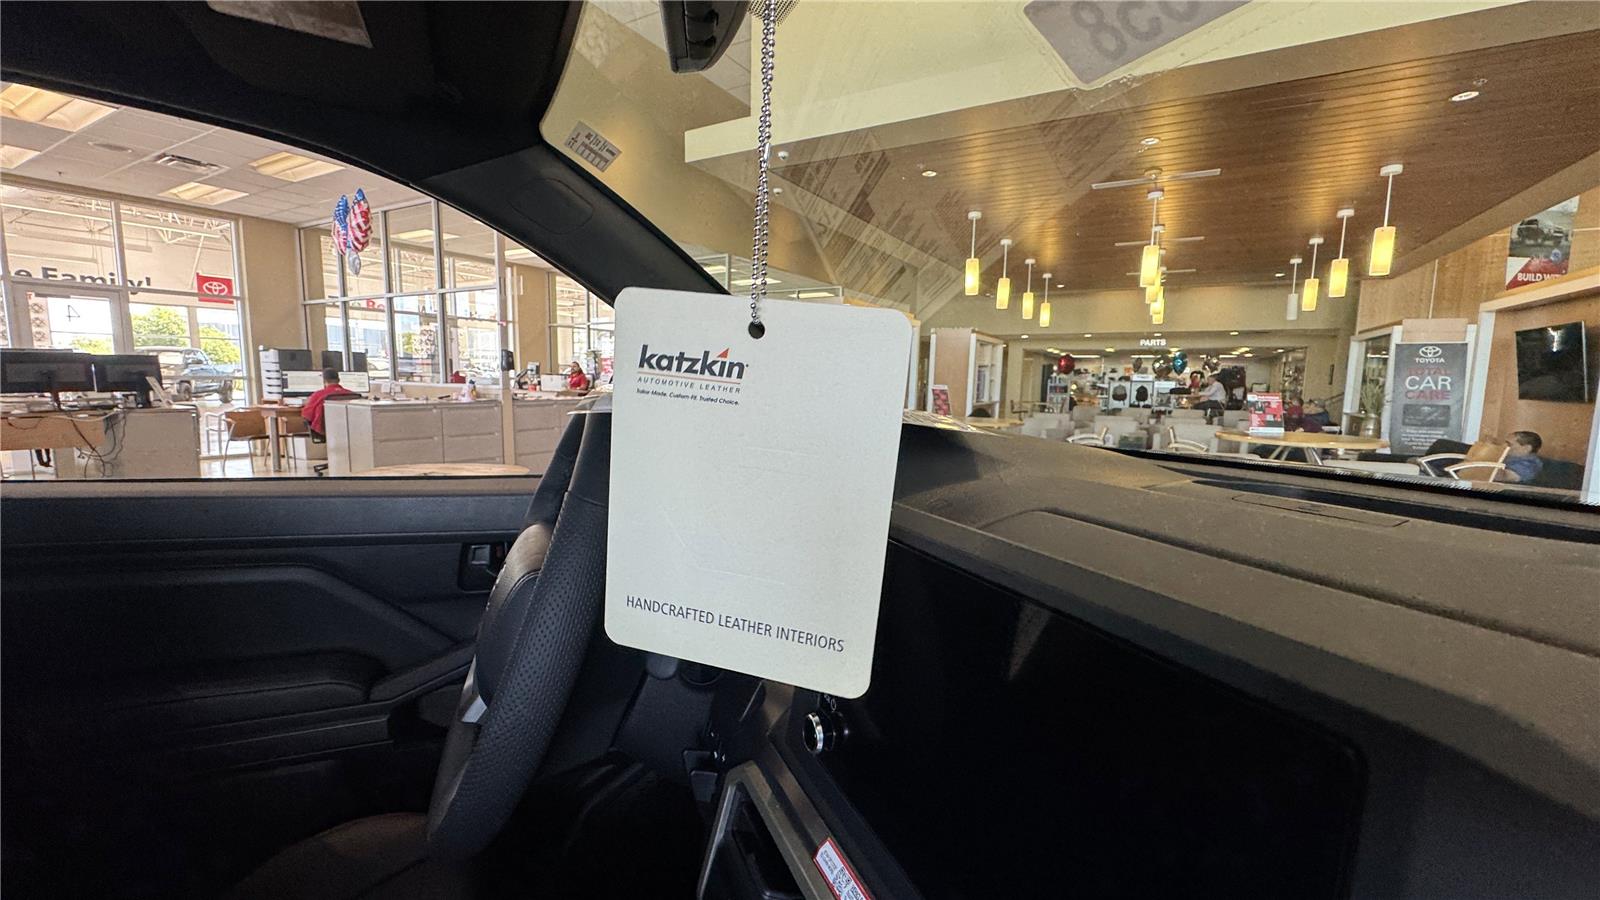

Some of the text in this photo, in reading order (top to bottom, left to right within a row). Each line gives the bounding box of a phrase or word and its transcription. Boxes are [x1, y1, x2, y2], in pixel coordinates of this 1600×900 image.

[1517, 272, 1543, 281] BUILD
[1139, 338, 1167, 346] PARTS
[638, 344, 746, 380] katzkin
[637, 376, 741, 394] AUTOMOTIVE LEATHER
[1405, 375, 1452, 390] CAR
[699, 395, 718, 403] Trusted
[1405, 391, 1452, 400] CARE
[626, 595, 845, 652] HANDCRAFTED LEATHER INTERIORS
